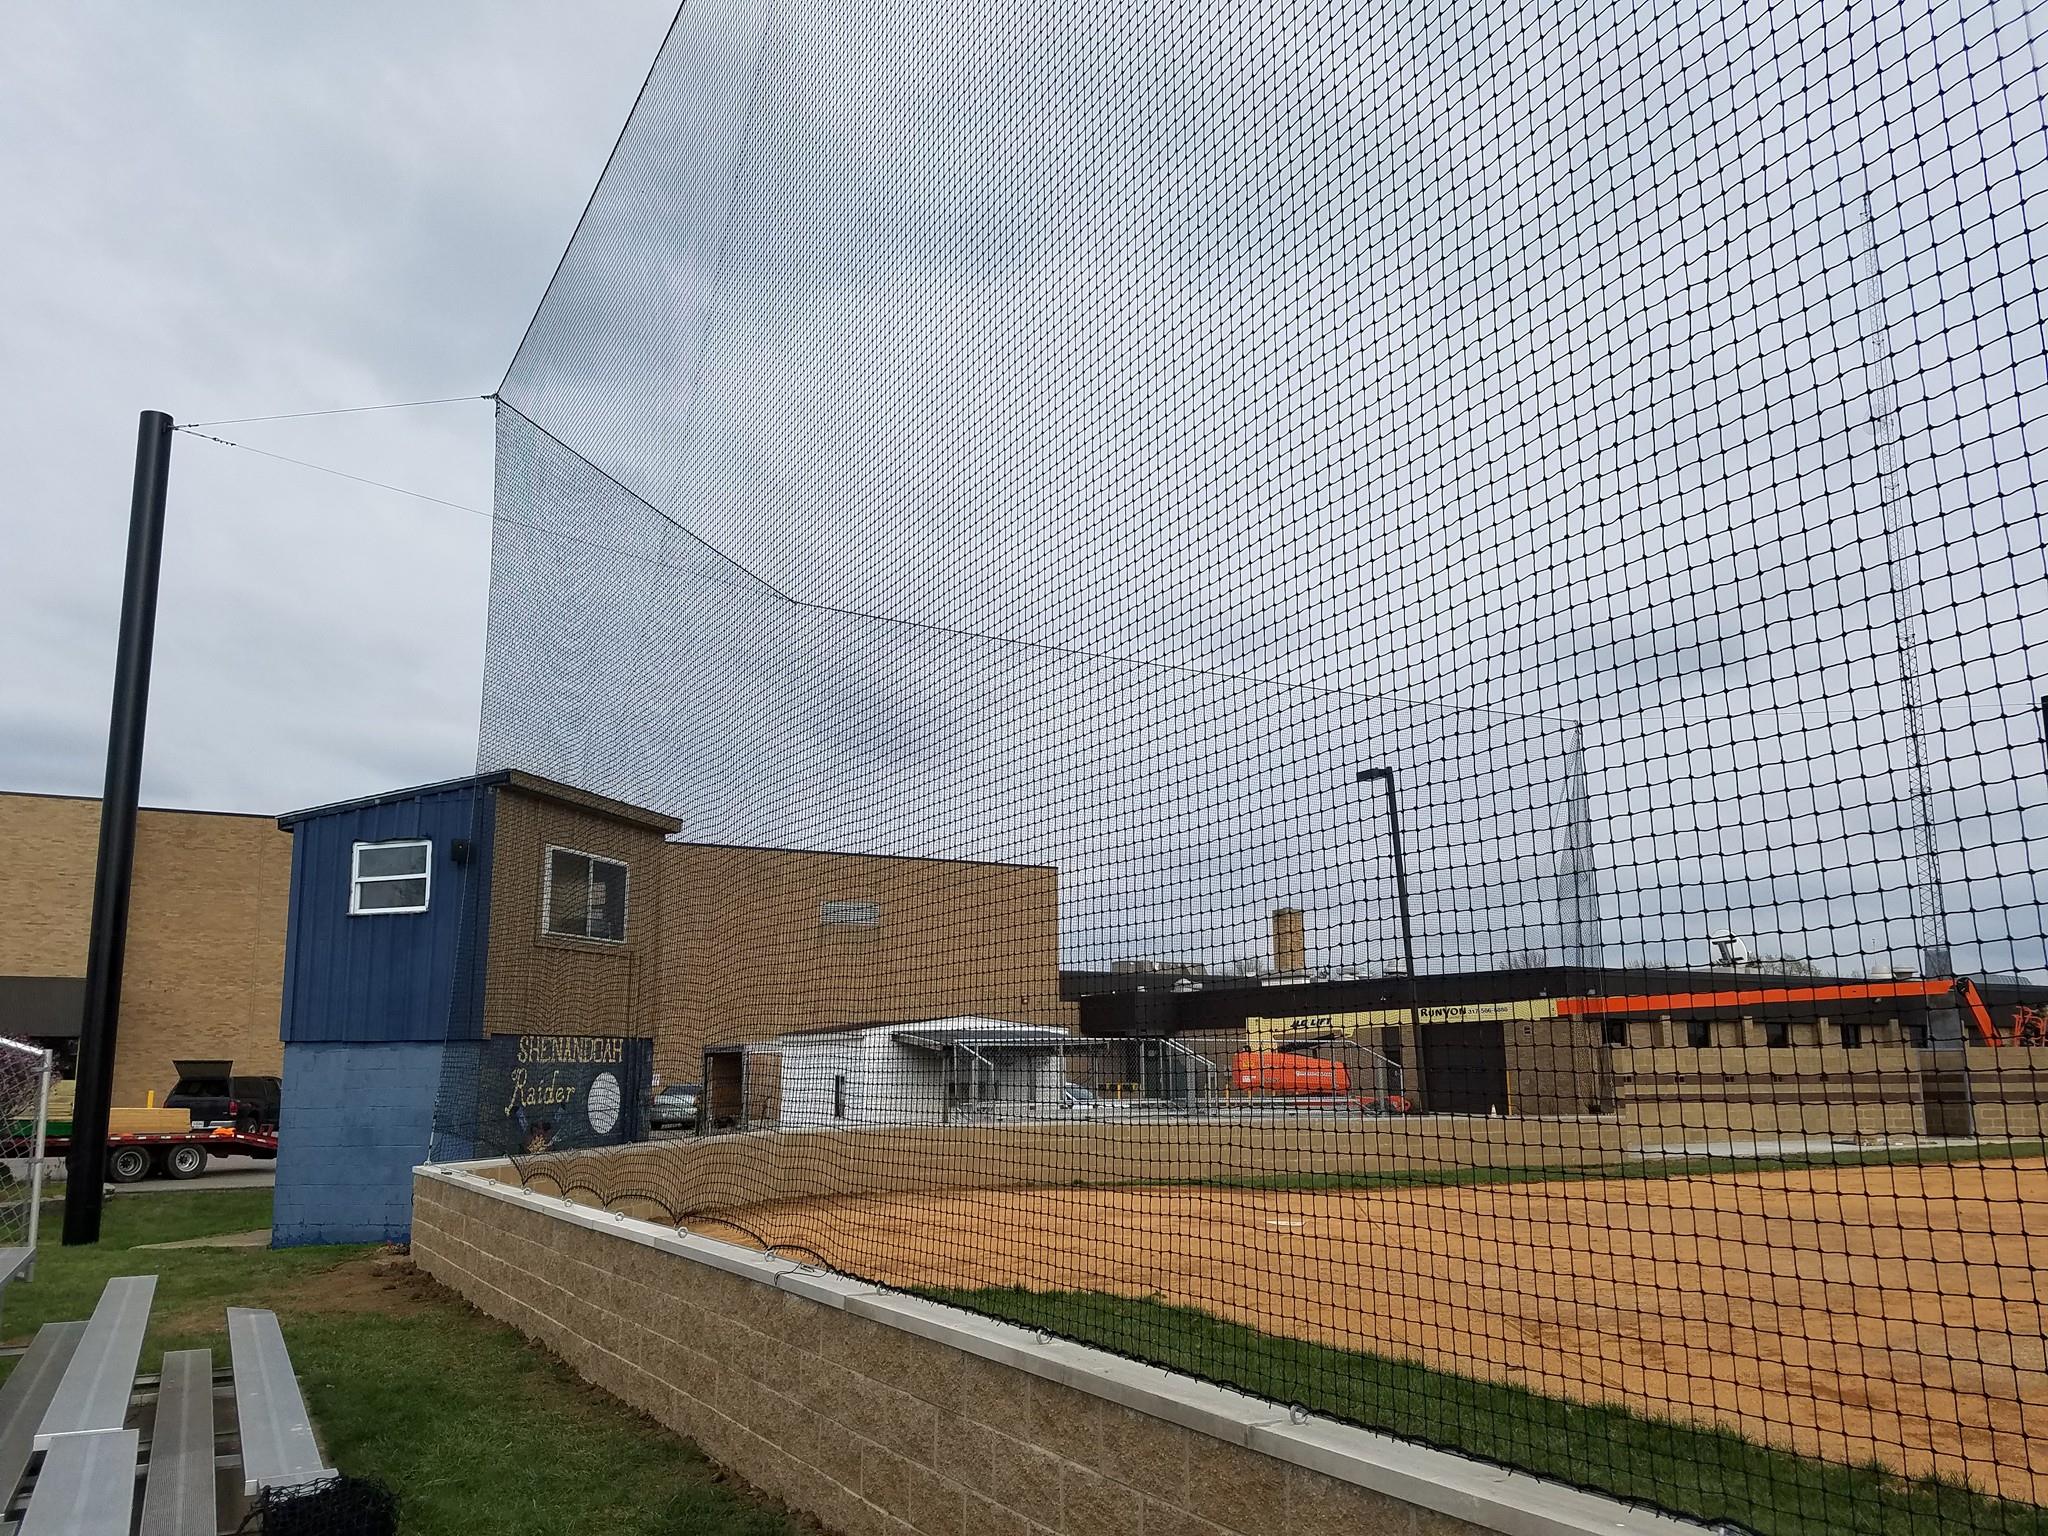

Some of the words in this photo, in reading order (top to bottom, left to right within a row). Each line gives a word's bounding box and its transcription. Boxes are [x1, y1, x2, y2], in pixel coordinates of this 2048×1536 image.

[1420, 1007, 1467, 1017] RUNYON
[1310, 1017, 1332, 1027] LIFT
[517, 1035, 624, 1064] SHENANDOAH
[504, 1067, 576, 1117] Raider
